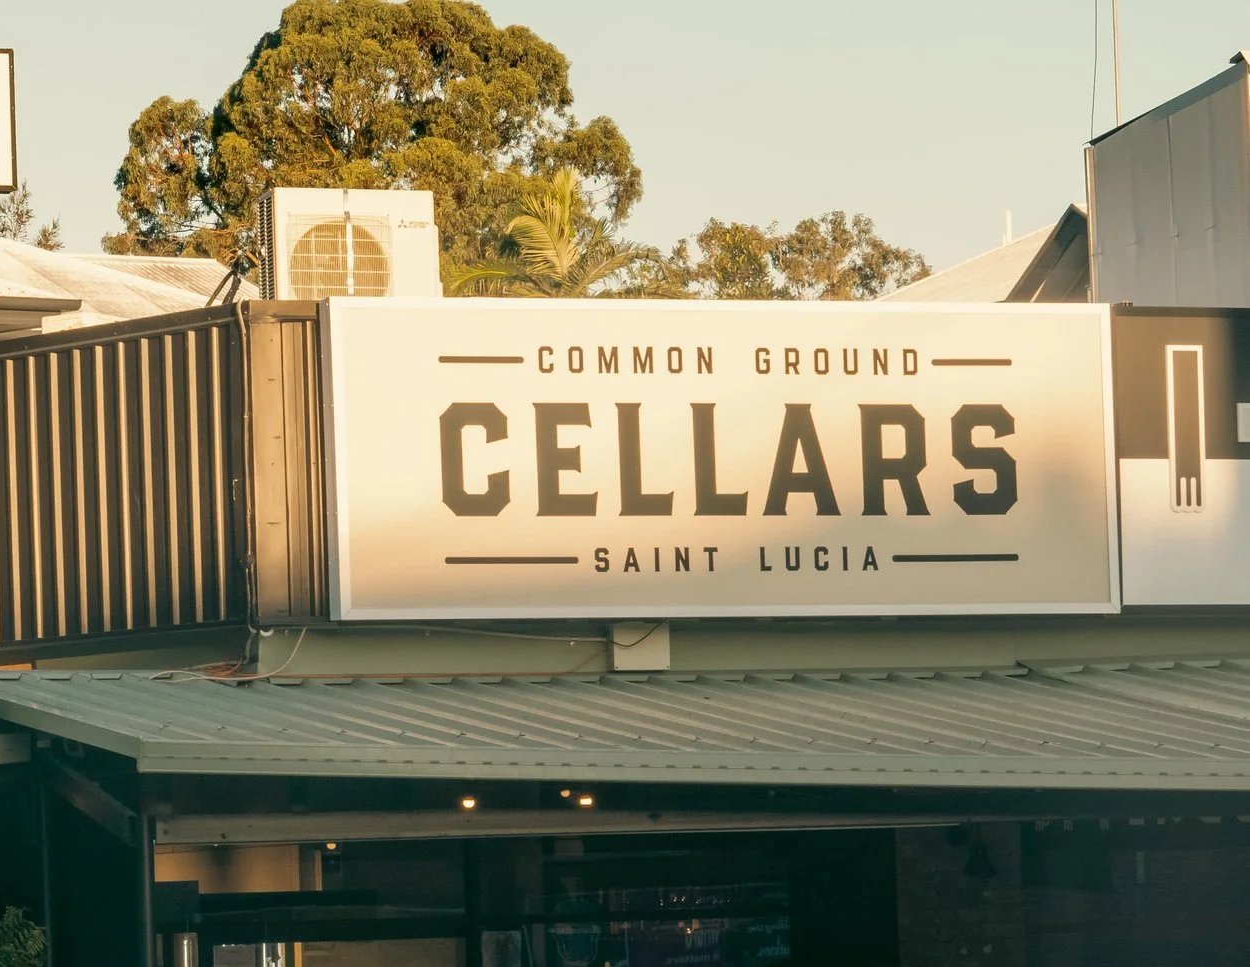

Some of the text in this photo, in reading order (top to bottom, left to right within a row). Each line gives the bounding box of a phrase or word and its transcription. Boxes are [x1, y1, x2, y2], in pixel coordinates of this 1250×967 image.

[537, 345, 919, 376] COMMON GROUND
[438, 401, 1019, 517] CELLARS
[593, 545, 881, 573] SAINT LUCIA
